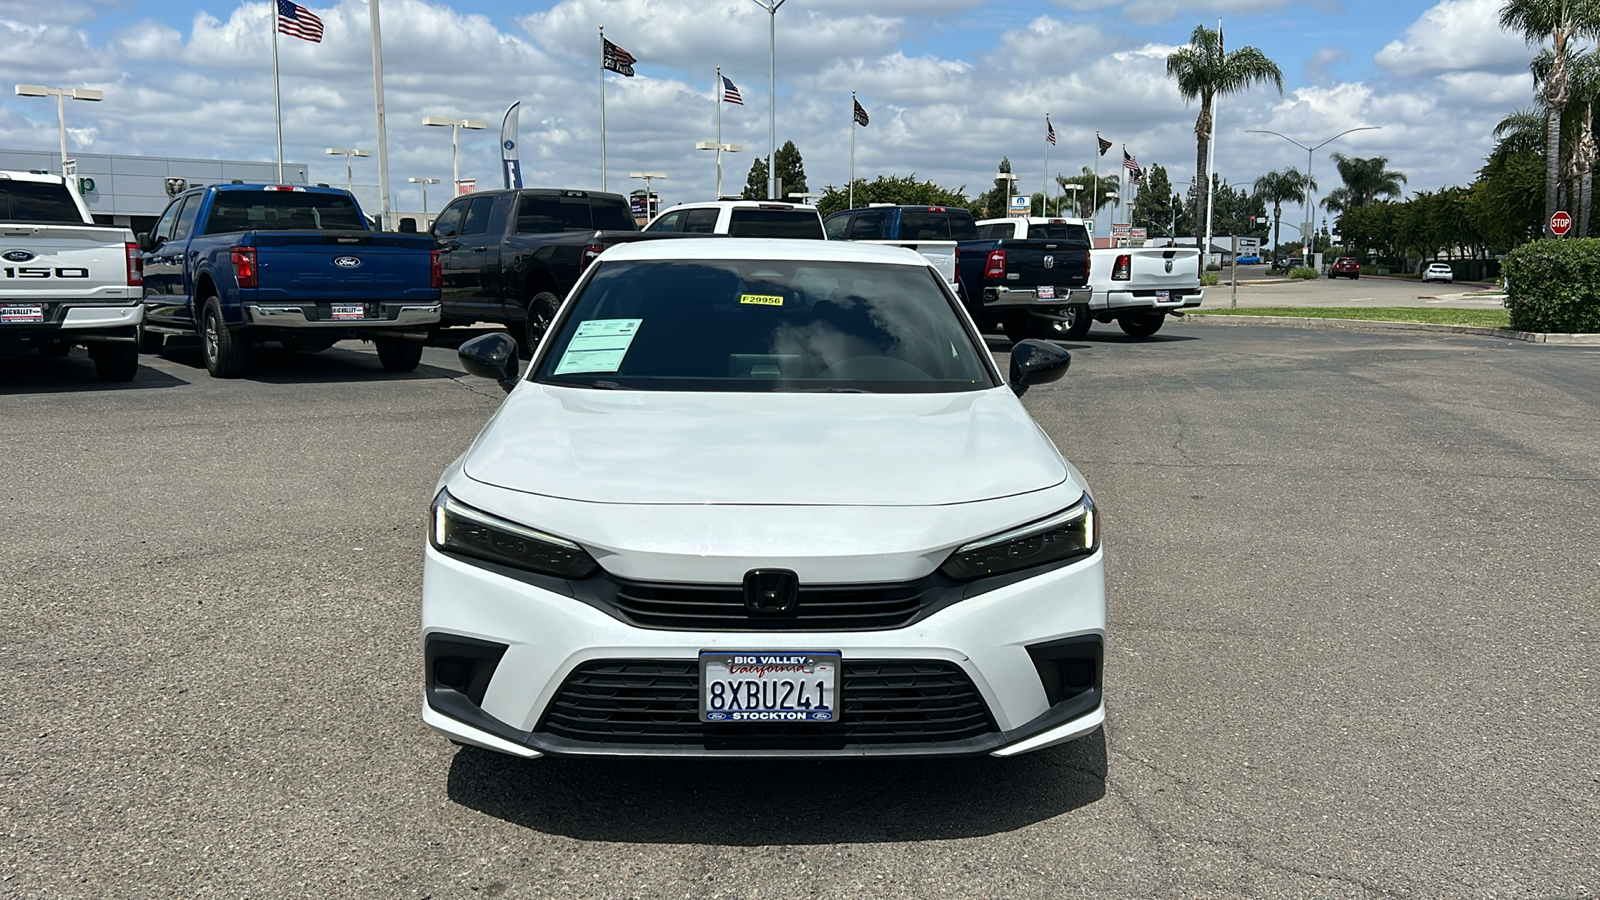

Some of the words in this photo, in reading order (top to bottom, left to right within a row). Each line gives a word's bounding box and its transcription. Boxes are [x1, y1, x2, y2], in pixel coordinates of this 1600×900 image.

[1552, 218, 1569, 228] STOP
[742, 296, 781, 304] F29956
[734, 656, 757, 664] BIG
[761, 656, 806, 664] VALLEY
[710, 680, 829, 710] 8XBU241
[732, 712, 806, 720] STOCKTON
